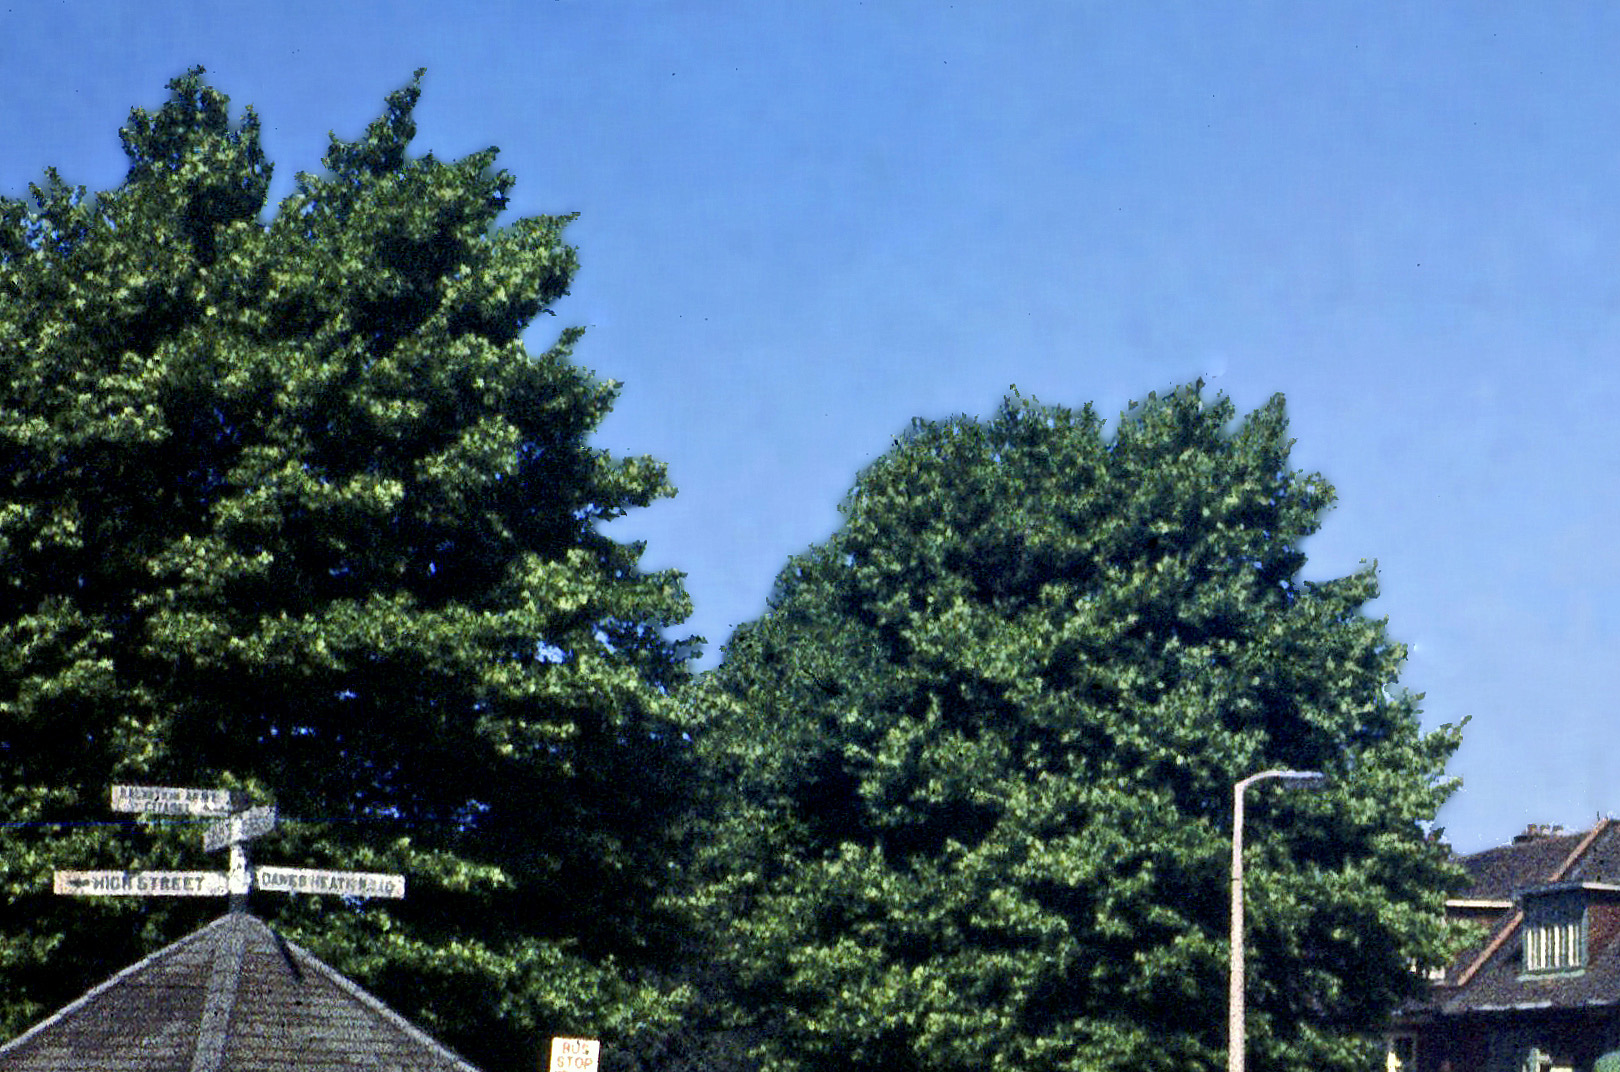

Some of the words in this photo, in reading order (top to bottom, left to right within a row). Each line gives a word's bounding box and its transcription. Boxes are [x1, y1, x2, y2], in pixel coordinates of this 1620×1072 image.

[92, 875, 131, 890] HIGH
[137, 874, 202, 891] STREET
[562, 1041, 589, 1055] BUS
[557, 1056, 593, 1069] STOP
